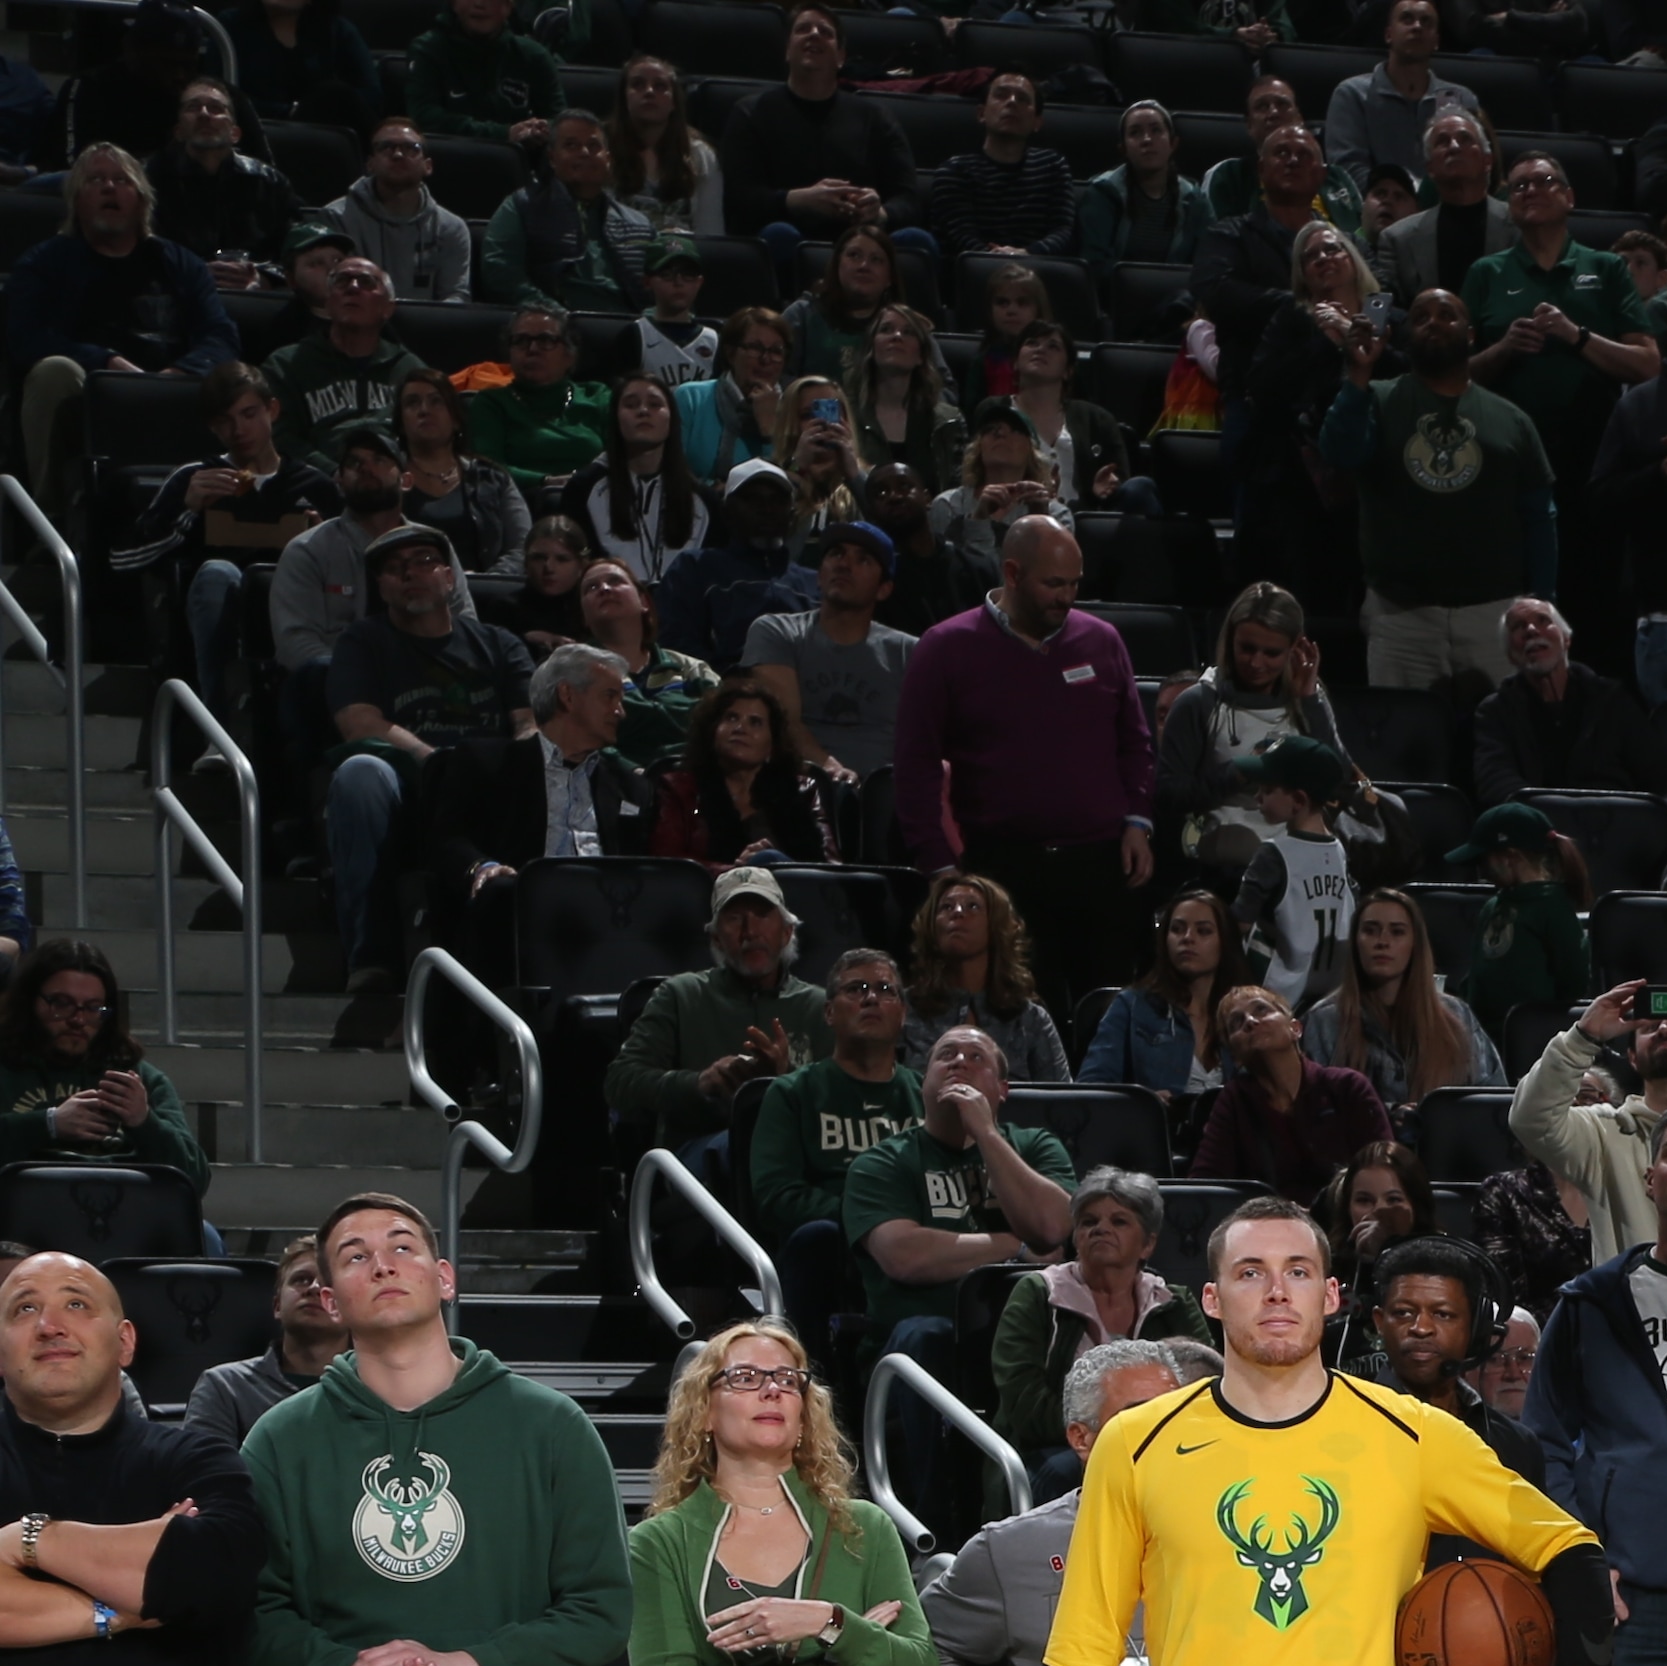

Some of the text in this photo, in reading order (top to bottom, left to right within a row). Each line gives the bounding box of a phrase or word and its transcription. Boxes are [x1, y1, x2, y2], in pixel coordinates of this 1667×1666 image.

[1303, 874, 1346, 901] LOPEZ
[1313, 908, 1338, 971] 11
[364, 1531, 459, 1576] MILWAUKEE BUCKS
